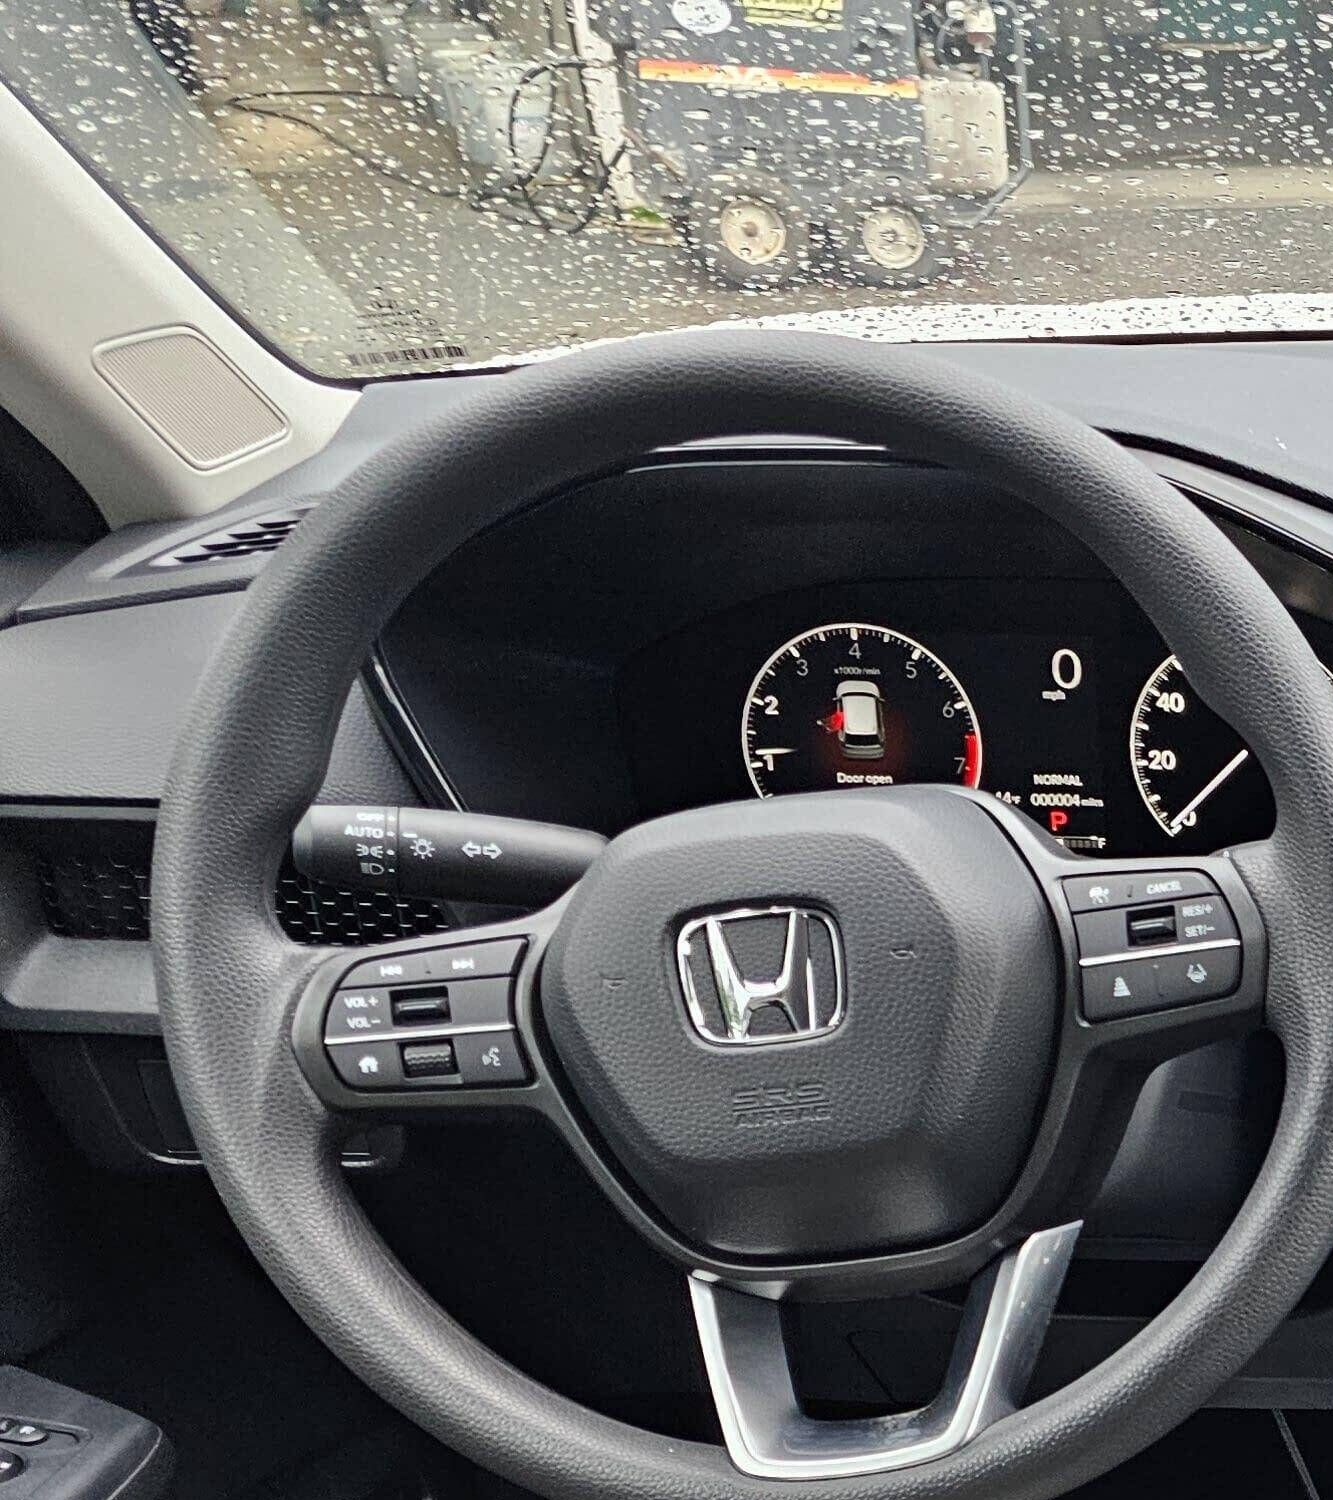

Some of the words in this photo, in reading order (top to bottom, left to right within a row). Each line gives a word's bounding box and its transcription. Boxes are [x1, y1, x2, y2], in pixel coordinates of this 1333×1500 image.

[849, 643, 861, 659] 4
[796, 659, 809, 677] 3
[905, 661, 917, 679] 5
[1051, 649, 1082, 690] 0
[764, 696, 779, 716] 2
[942, 702, 955, 719] 6
[1156, 692, 1186, 713] 40
[954, 757, 966, 775] 7
[1148, 750, 1176, 771] 20
[837, 772, 863, 784] Door
[865, 774, 894, 786] open
[1033, 774, 1084, 787] NORMAL
[1030, 793, 1080, 807] 000004
[1050, 811, 1068, 831] P
[345, 825, 384, 839] AUTO
[1146, 881, 1183, 895] CANCEL
[734, 1083, 826, 1111] SRS
